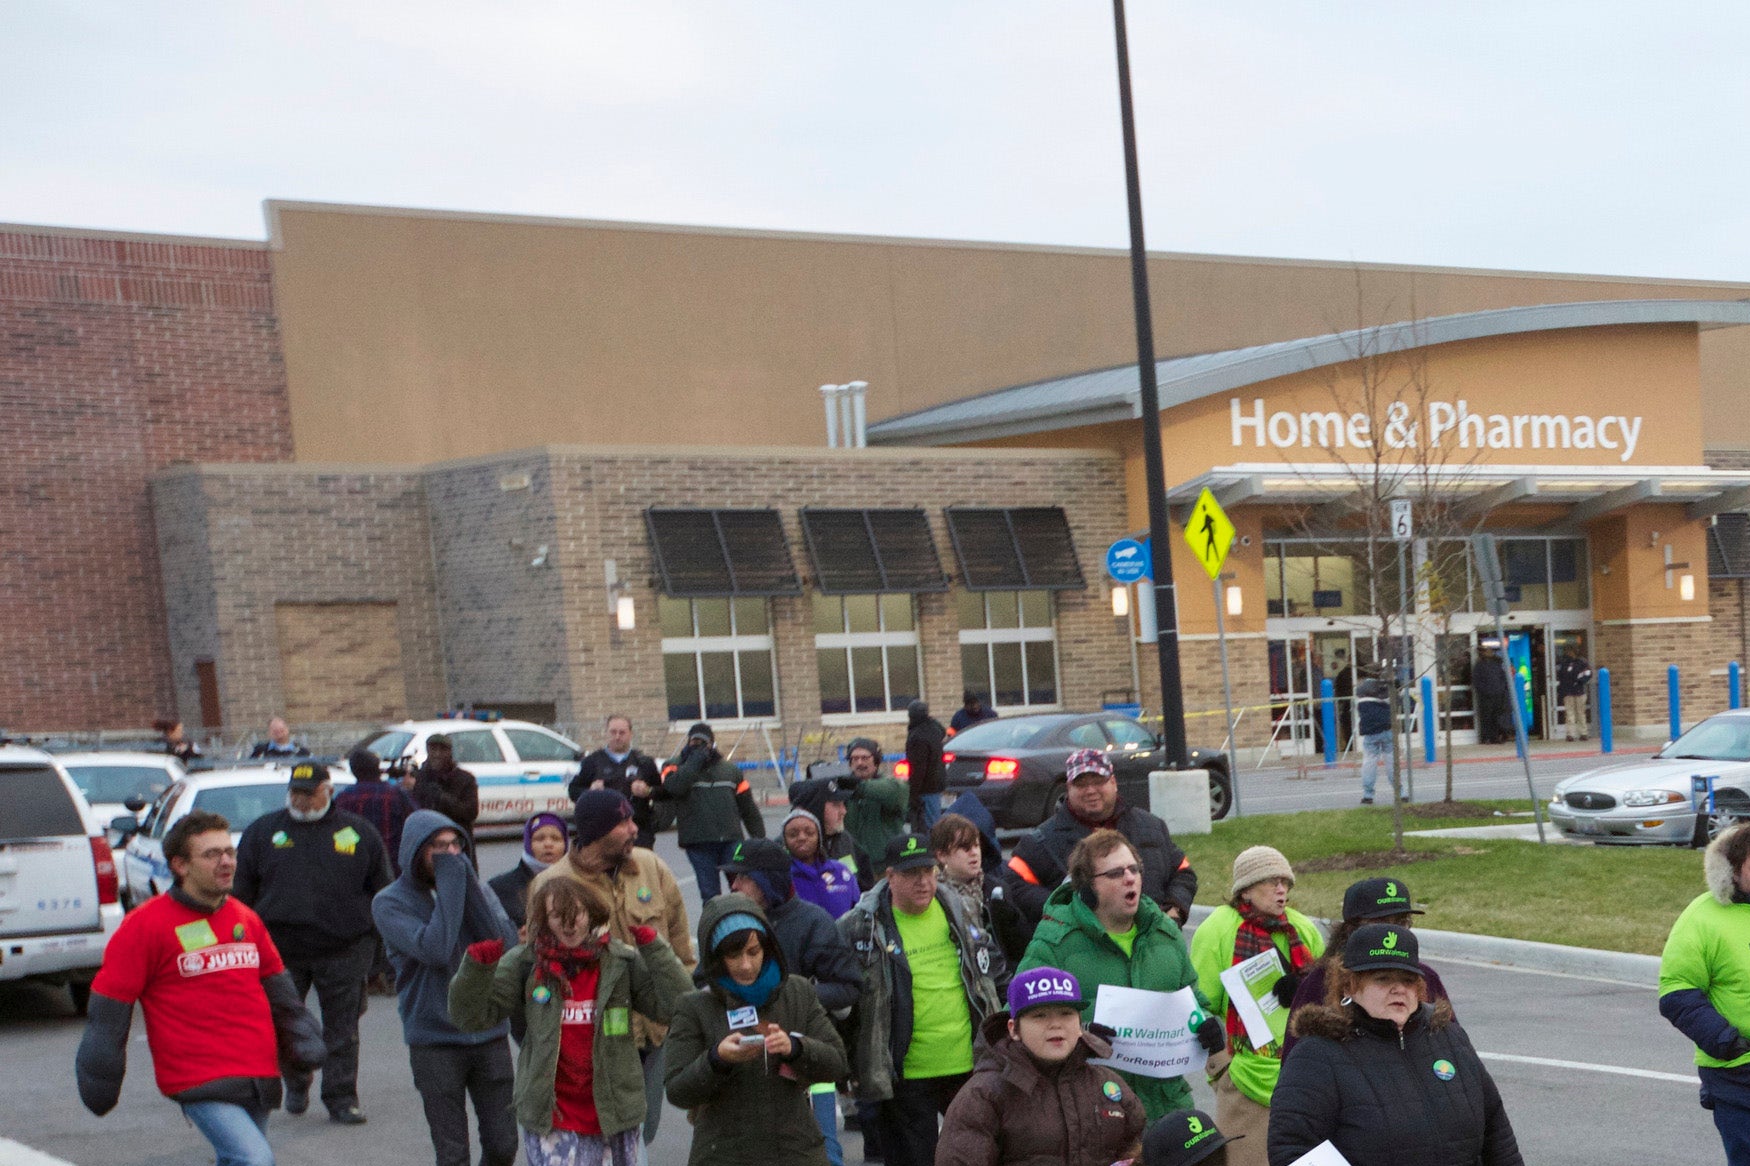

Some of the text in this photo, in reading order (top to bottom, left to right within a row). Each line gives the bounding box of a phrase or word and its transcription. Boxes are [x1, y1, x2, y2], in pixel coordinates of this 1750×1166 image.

[1230, 398, 1642, 462] Home & Pharmacy
[1397, 514, 1407, 536] 6
[480, 798, 574, 812] HICAGO POL
[1025, 978, 1073, 994] YOLO
[1116, 1053, 1190, 1068] ForRespect.org
